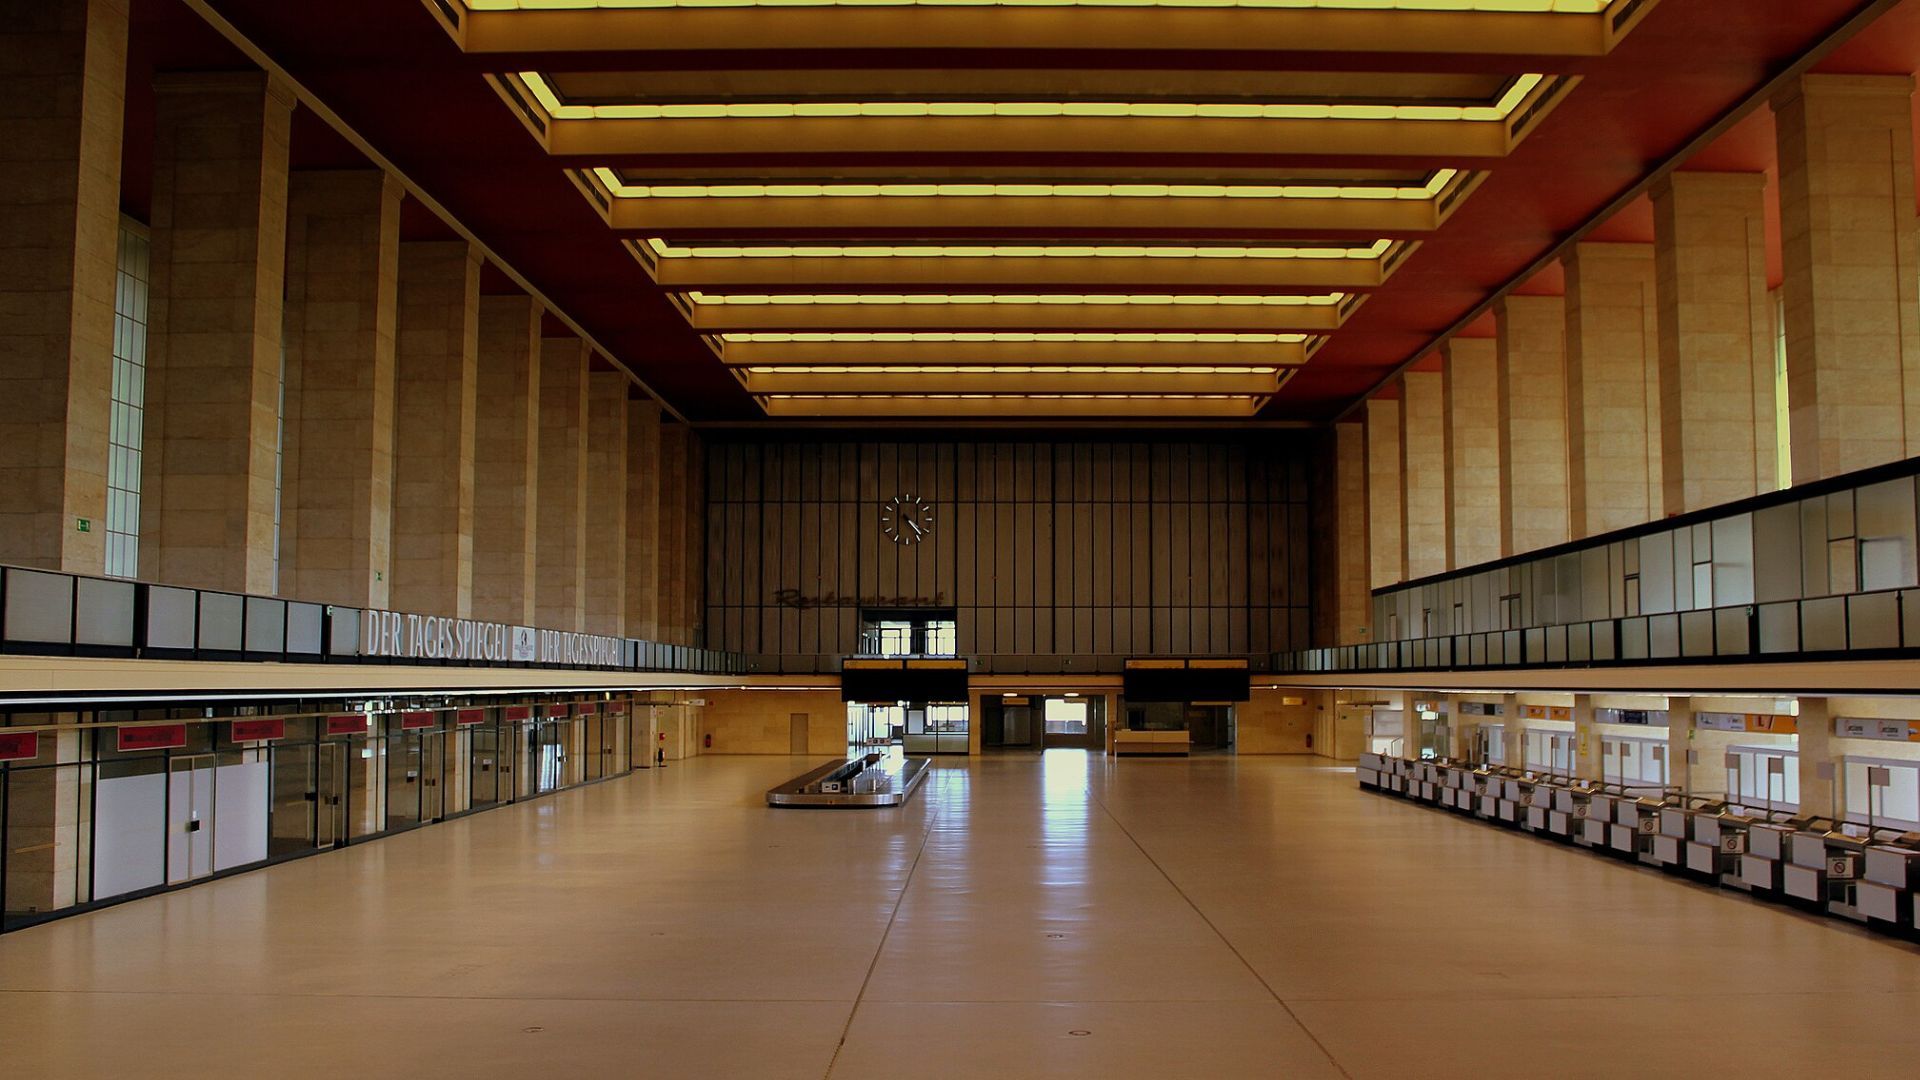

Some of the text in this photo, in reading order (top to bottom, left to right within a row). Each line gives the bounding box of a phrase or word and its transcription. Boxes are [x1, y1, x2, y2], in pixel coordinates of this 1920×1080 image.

[367, 609, 401, 656] DER
[541, 629, 620, 666] DER TAGESSPIEGEL
